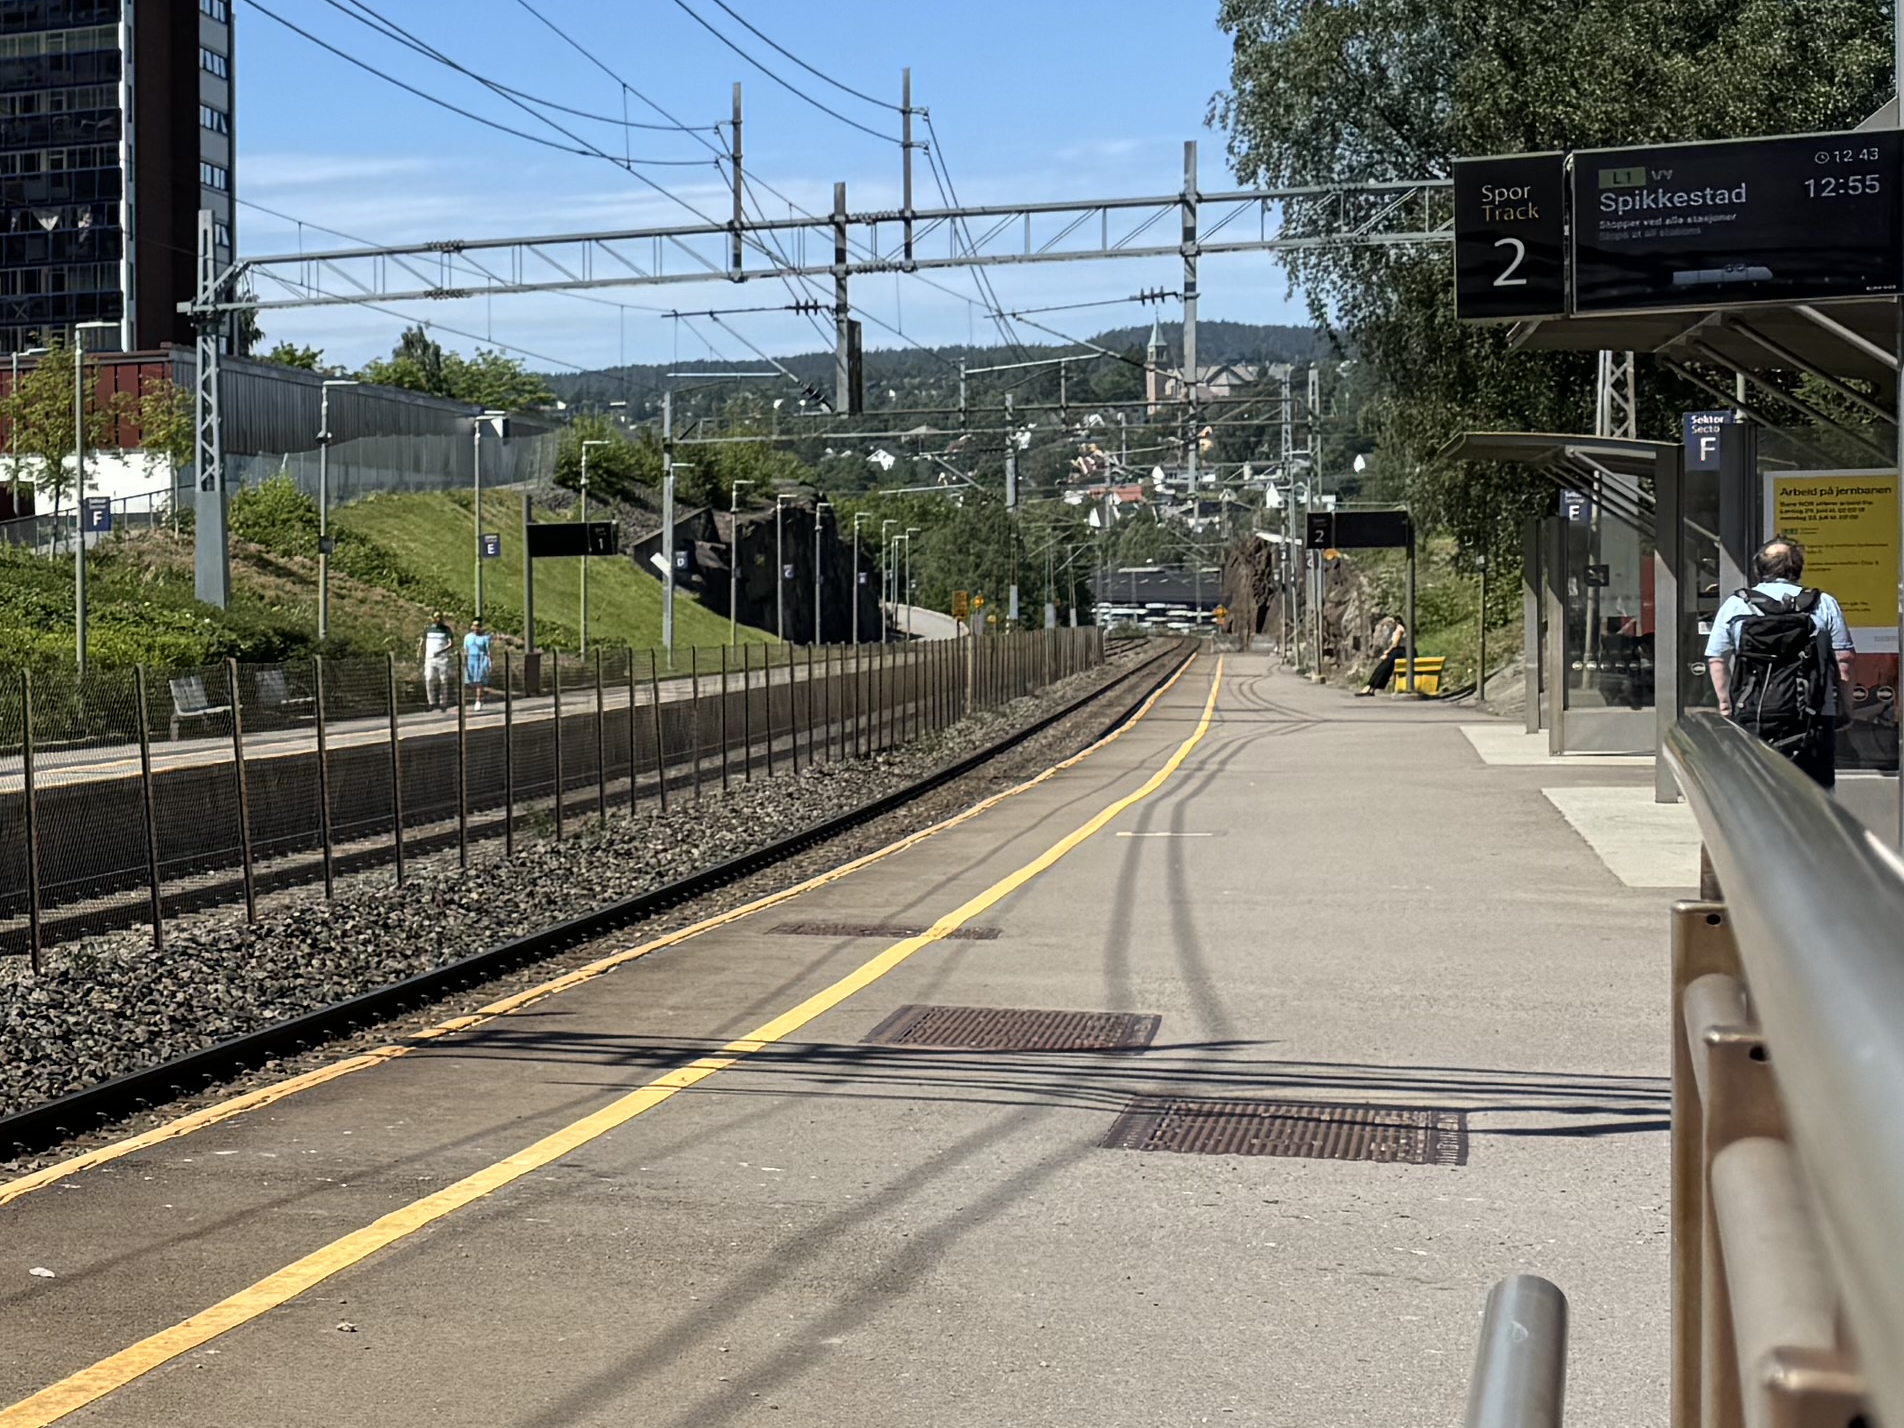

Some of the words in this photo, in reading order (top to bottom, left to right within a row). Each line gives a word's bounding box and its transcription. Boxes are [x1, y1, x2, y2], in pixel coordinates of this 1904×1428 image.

[1613, 171, 1631, 185] L1
[1804, 174, 1880, 198] 12:55
[1481, 184, 1531, 205] Spor
[1599, 182, 1746, 215] Spikkestad
[1481, 202, 1539, 222] Track
[1493, 237, 1527, 287] 2
[1691, 414, 1724, 424] Sektor
[1691, 424, 1720, 434] Secto
[1700, 437, 1717, 462] F
[1780, 487, 1818, 496] Arbeid
[1819, 486, 1835, 497] på
[1835, 486, 1892, 497] jernbanen
[93, 510, 103, 526] F
[1568, 505, 1580, 521] E
[1315, 530, 1325, 543] 2
[487, 543, 496, 555] E
